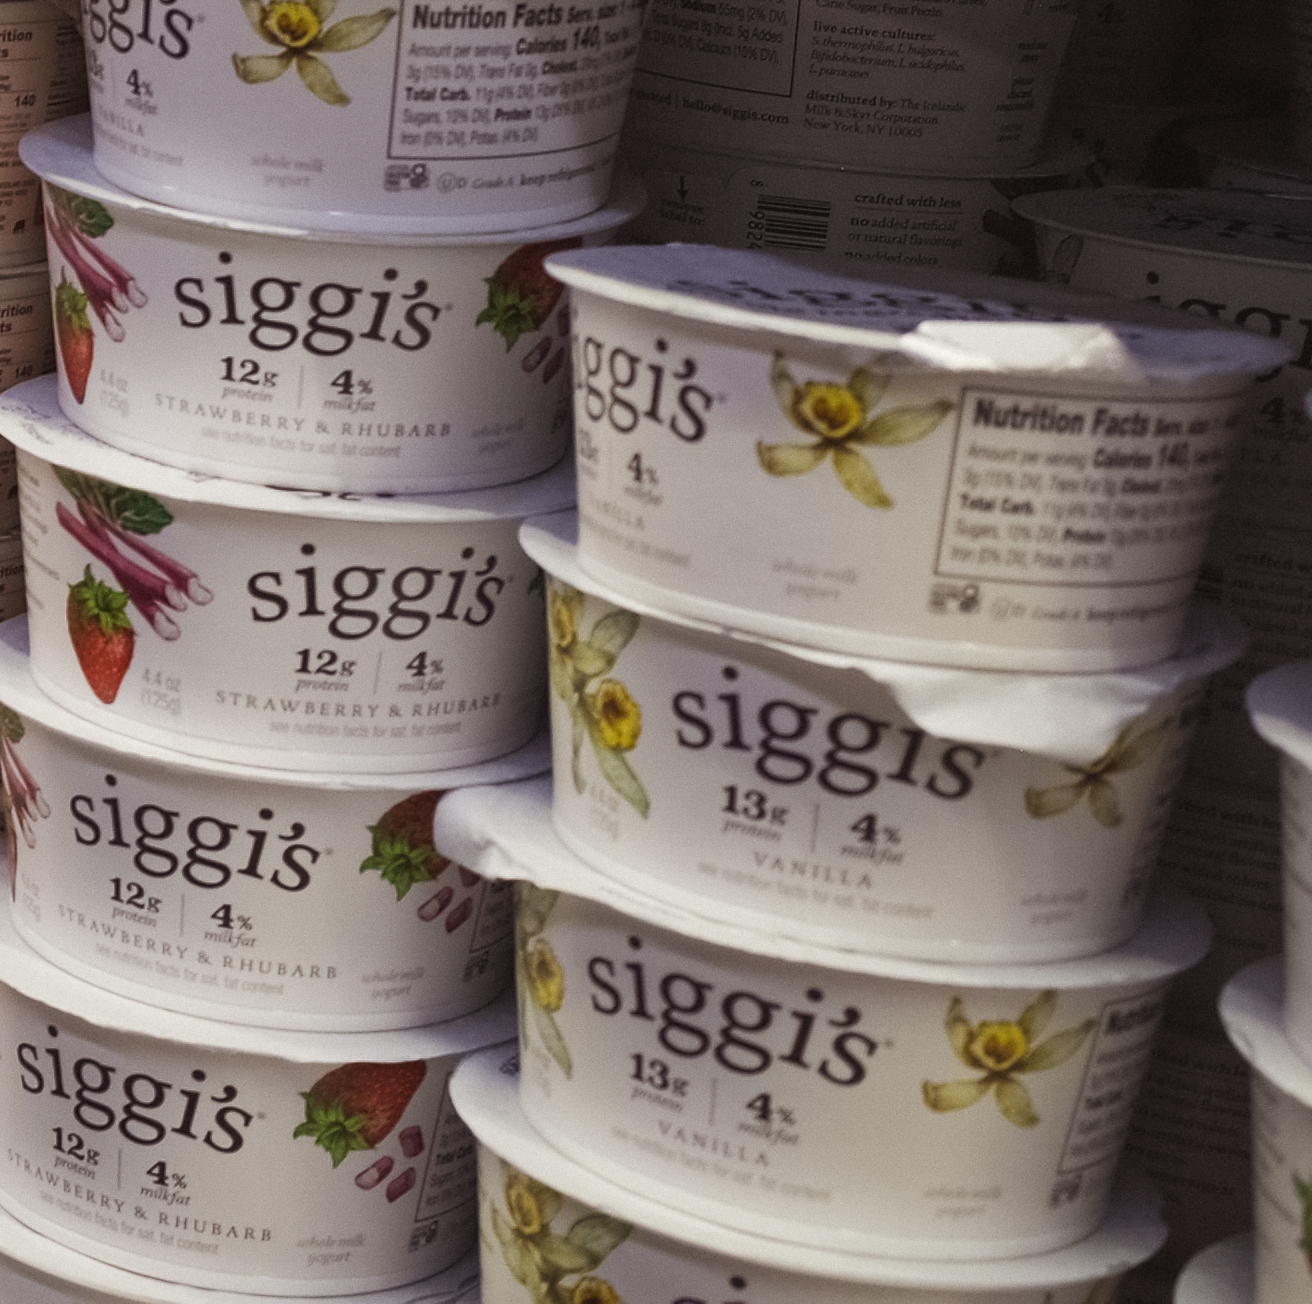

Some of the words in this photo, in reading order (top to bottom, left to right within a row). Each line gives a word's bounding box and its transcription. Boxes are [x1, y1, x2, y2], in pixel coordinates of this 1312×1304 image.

[413, 4, 506, 31] Nutrition
[512, 2, 563, 28] Facts
[174, 251, 442, 356] siggi's
[246, 544, 506, 642] siggi's
[69, 774, 322, 892] siggi's
[587, 936, 880, 1087] siggi's
[16, 1025, 254, 1154] siggi's
